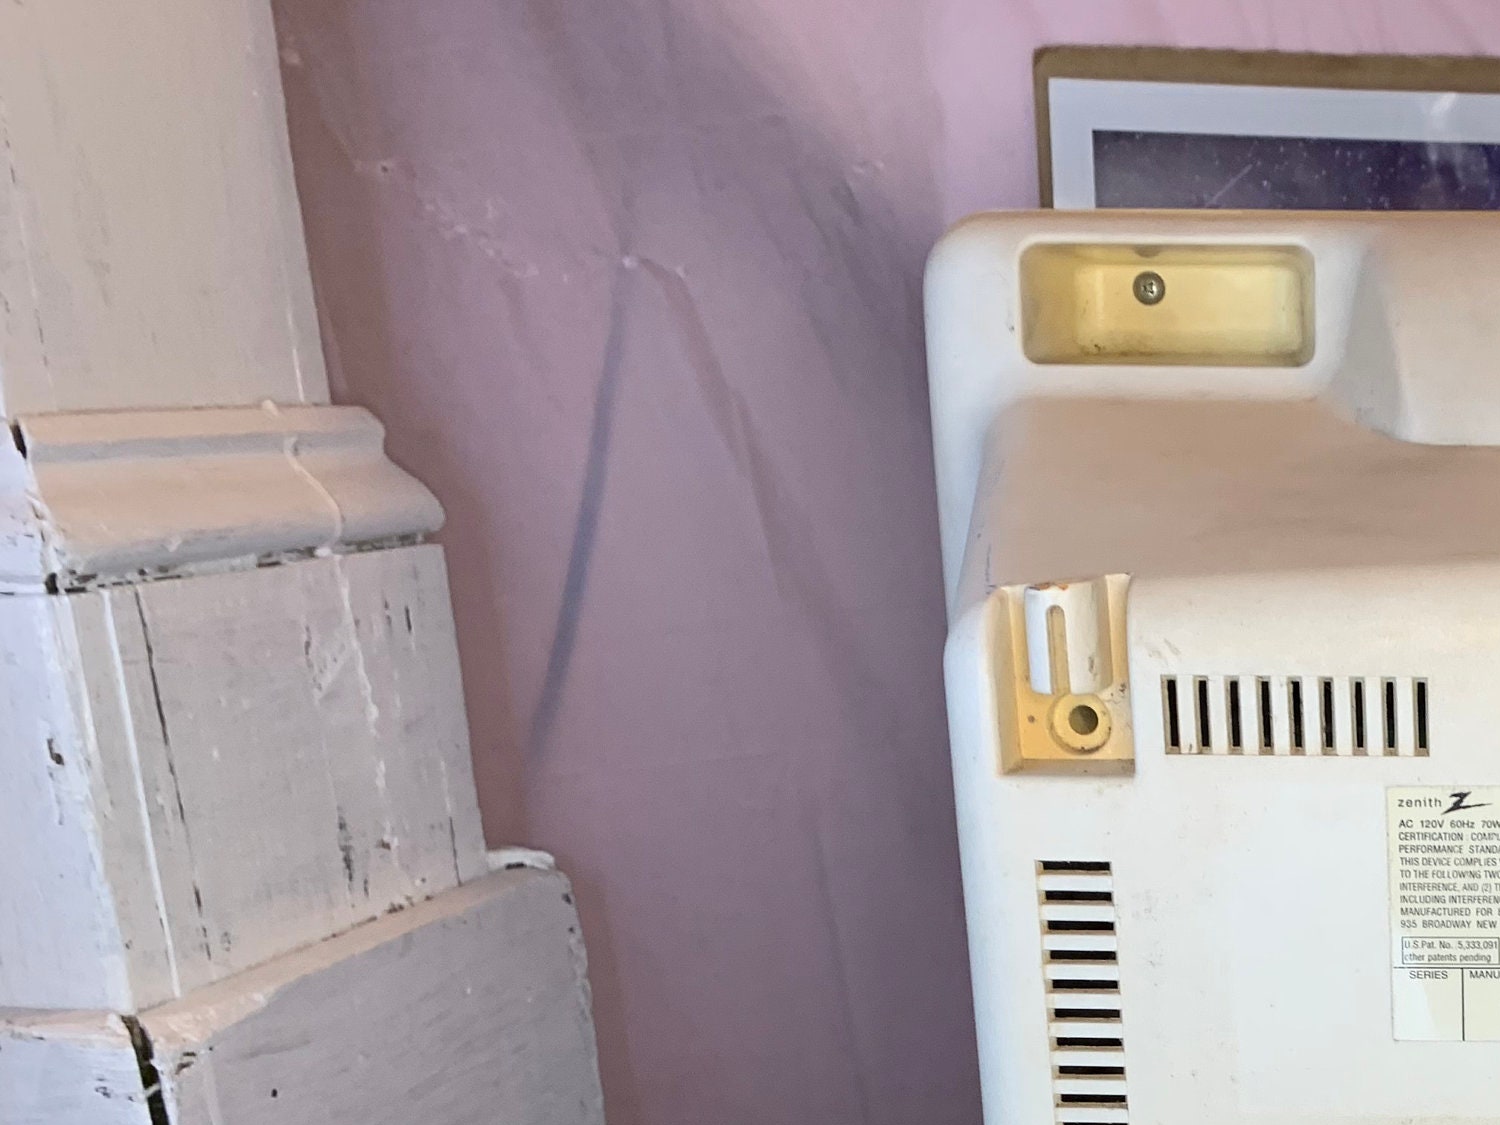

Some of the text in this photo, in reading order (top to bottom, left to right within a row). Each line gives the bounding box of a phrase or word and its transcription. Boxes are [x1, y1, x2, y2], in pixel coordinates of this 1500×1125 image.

[1398, 798, 1442, 808] zenith
[1398, 819, 1413, 828] AC
[1420, 819, 1444, 828] 120V
[1450, 819, 1475, 828] 60Hz
[1398, 845, 1462, 854] PERFORMANCE
[1400, 857, 1419, 866] THIS
[1422, 857, 1451, 866] DEVICE
[1454, 857, 1497, 866] COMPLIES
[1400, 870, 1411, 879] TO
[1414, 870, 1429, 879] THE
[1432, 870, 1481, 879] FOLLOWING
[1463, 883, 1479, 892] AND
[1481, 883, 1492, 893] (2)
[1400, 895, 1446, 904] INCLUDING
[1400, 908, 1471, 916] MANUFACTURED
[1476, 908, 1492, 916] FOR
[1422, 920, 1471, 929] BROADWAY
[1477, 920, 1497, 929] NEW
[1458, 940, 1497, 950] 5,333,091
[1428, 953, 1456, 962] patents
[1460, 953, 1491, 963] pending
[1409, 970, 1448, 979] SERIES
